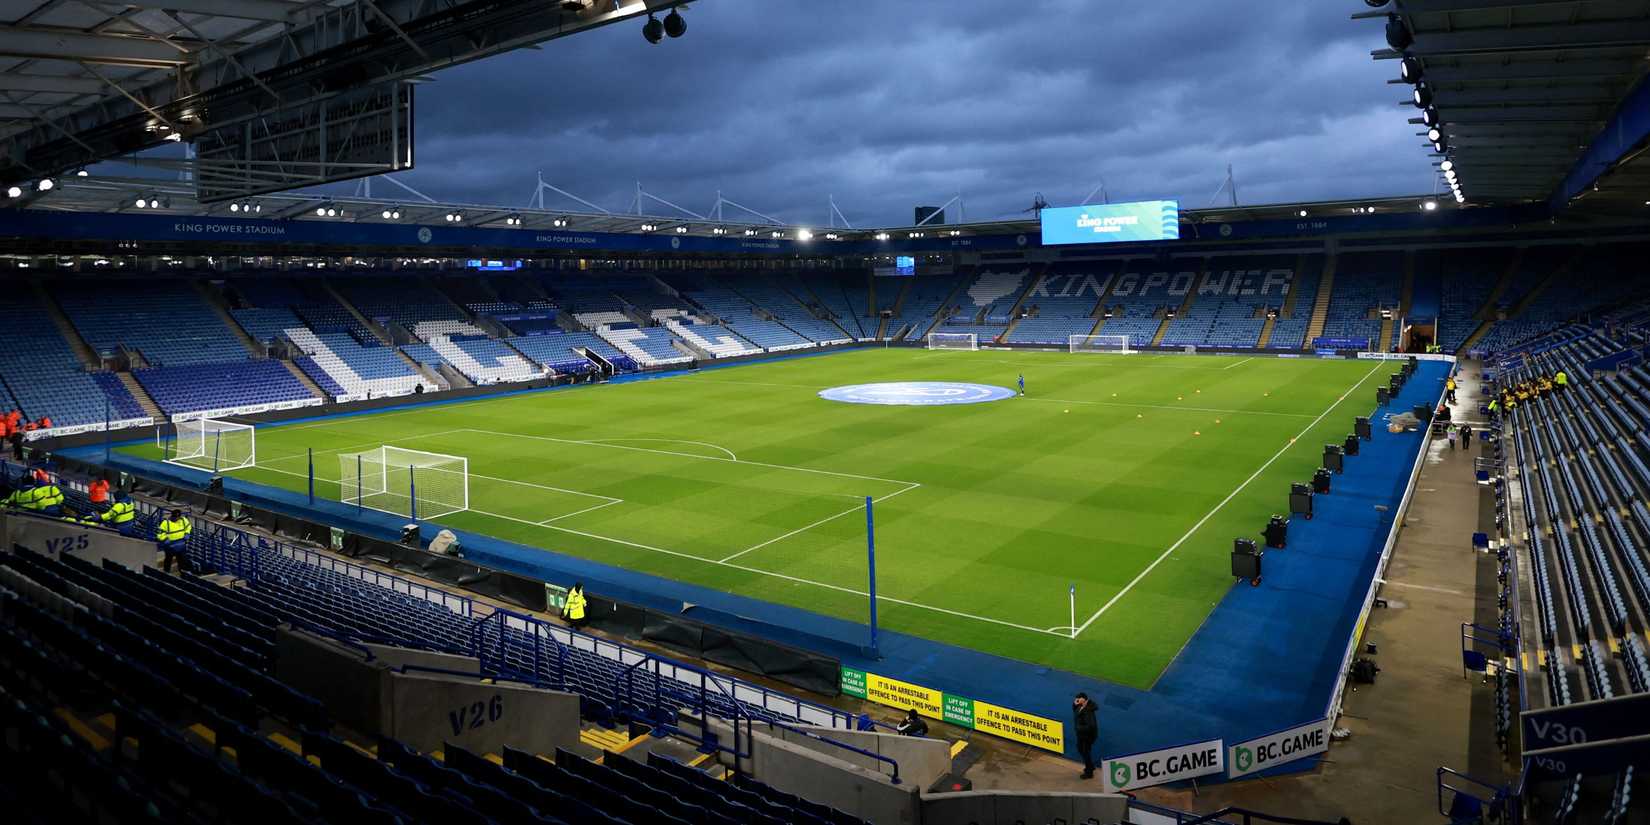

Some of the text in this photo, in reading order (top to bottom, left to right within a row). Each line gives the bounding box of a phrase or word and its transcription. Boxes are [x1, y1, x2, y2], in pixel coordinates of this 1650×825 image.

[174, 223, 285, 235] KING POWER STADIUM
[46, 534, 88, 554] V25
[869, 688, 890, 700] OFFENCE
[899, 697, 911, 706] PASS
[912, 700, 924, 709] THIS
[924, 704, 940, 713] POINT
[898, 687, 929, 701] ARRESTABLE
[949, 697, 959, 705] LIFT
[450, 695, 502, 736] V26
[944, 711, 972, 723] EMERGENCY
[952, 706, 963, 714] CASE
[987, 709, 1048, 732] IT IS AN ARRESTABLE
[976, 716, 1061, 746] OFFENCE TO PASS THIS POINT
[1531, 717, 1587, 743] V30
[1257, 729, 1324, 763] BC.GAME
[1136, 749, 1217, 780] BC.GAME
[1535, 755, 1566, 773] V30
